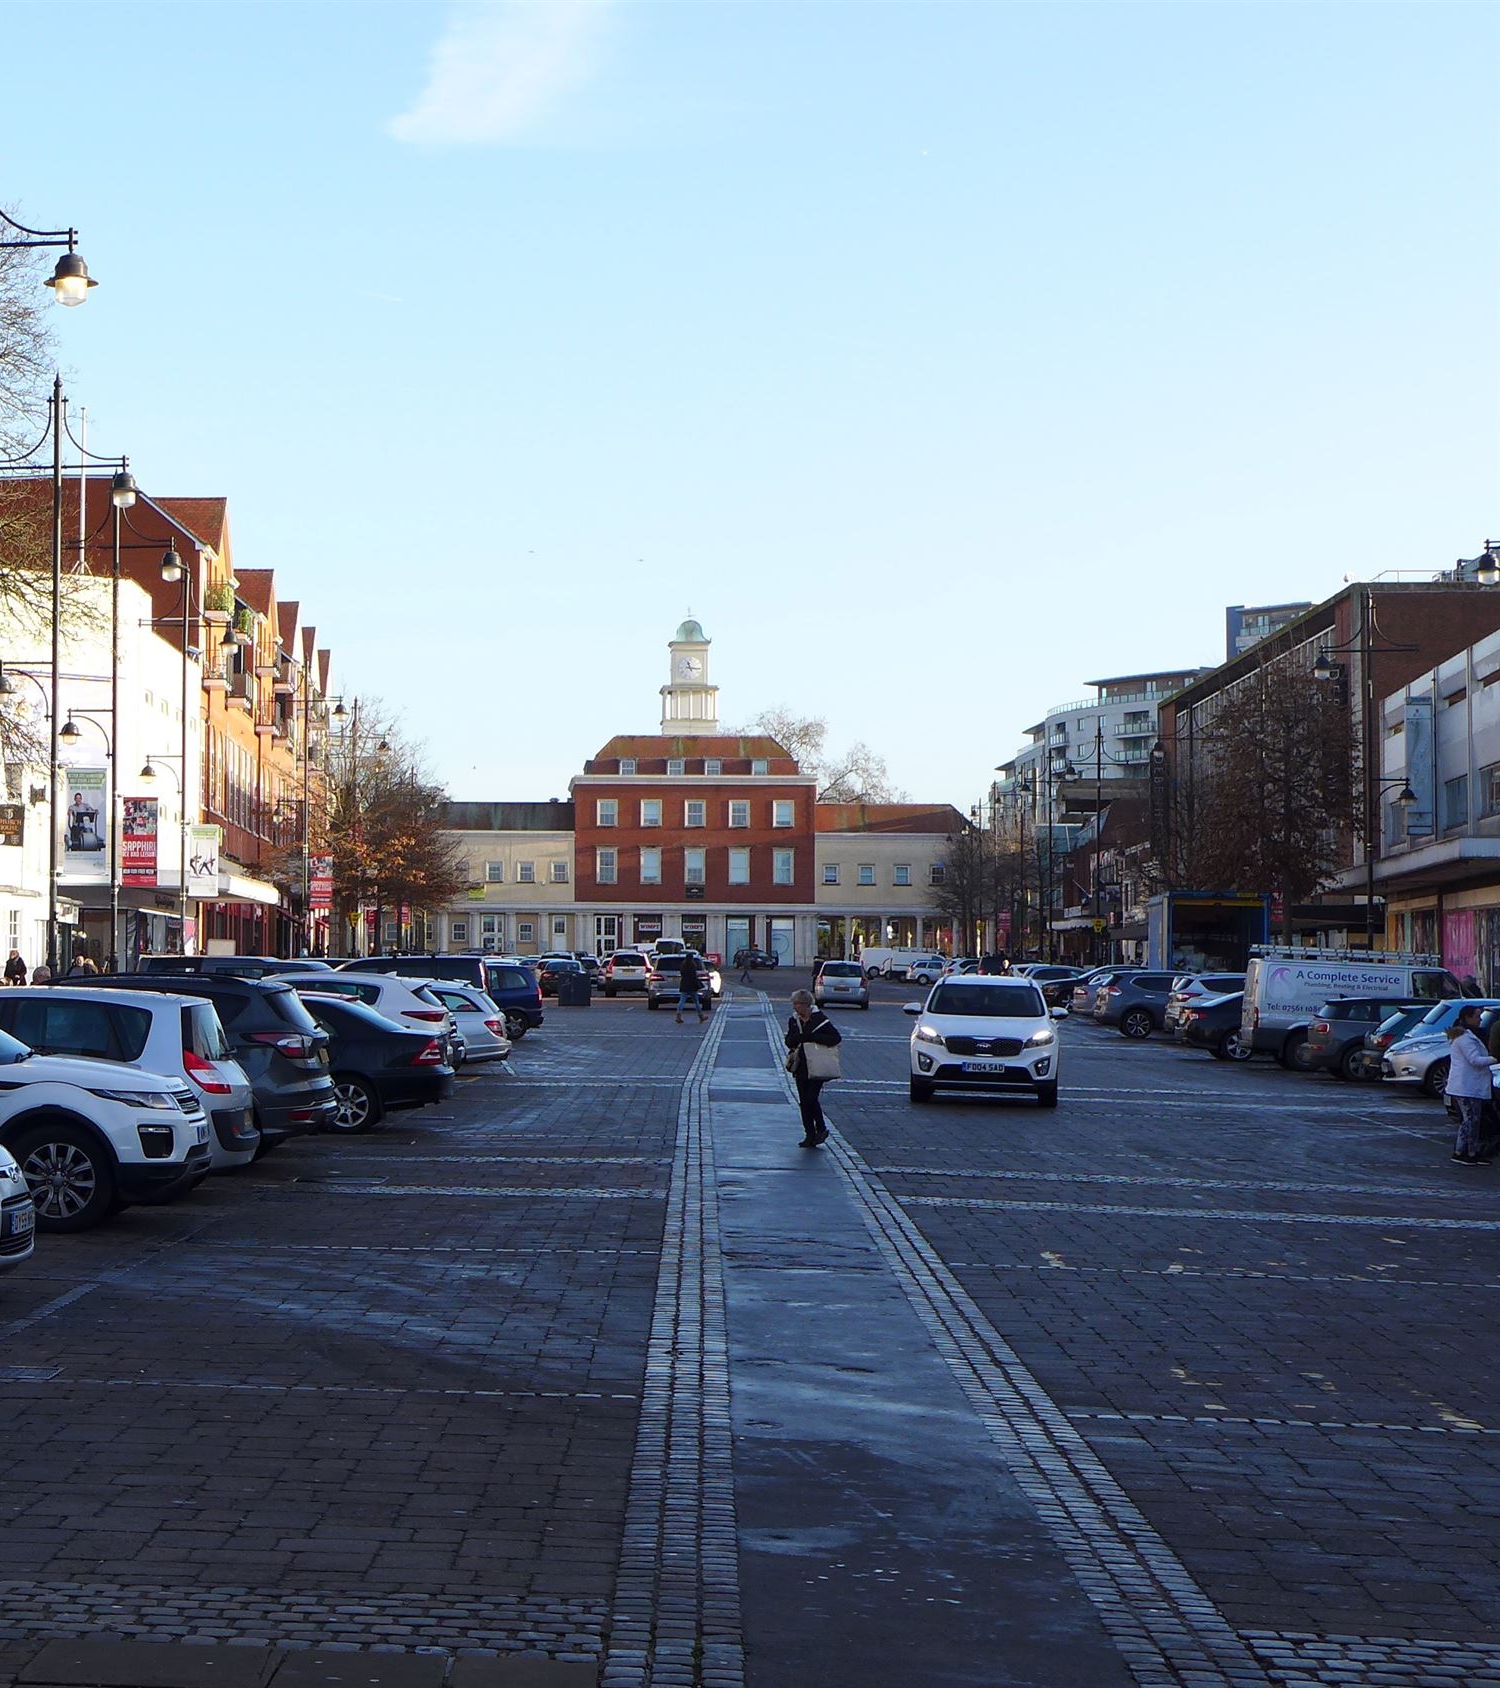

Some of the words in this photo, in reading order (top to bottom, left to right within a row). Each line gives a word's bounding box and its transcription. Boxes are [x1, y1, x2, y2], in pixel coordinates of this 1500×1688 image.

[1296, 970, 1304, 979] A
[1307, 970, 1358, 984] Complete
[1361, 973, 1400, 985] Service
[1267, 1002, 1281, 1011] Tel:
